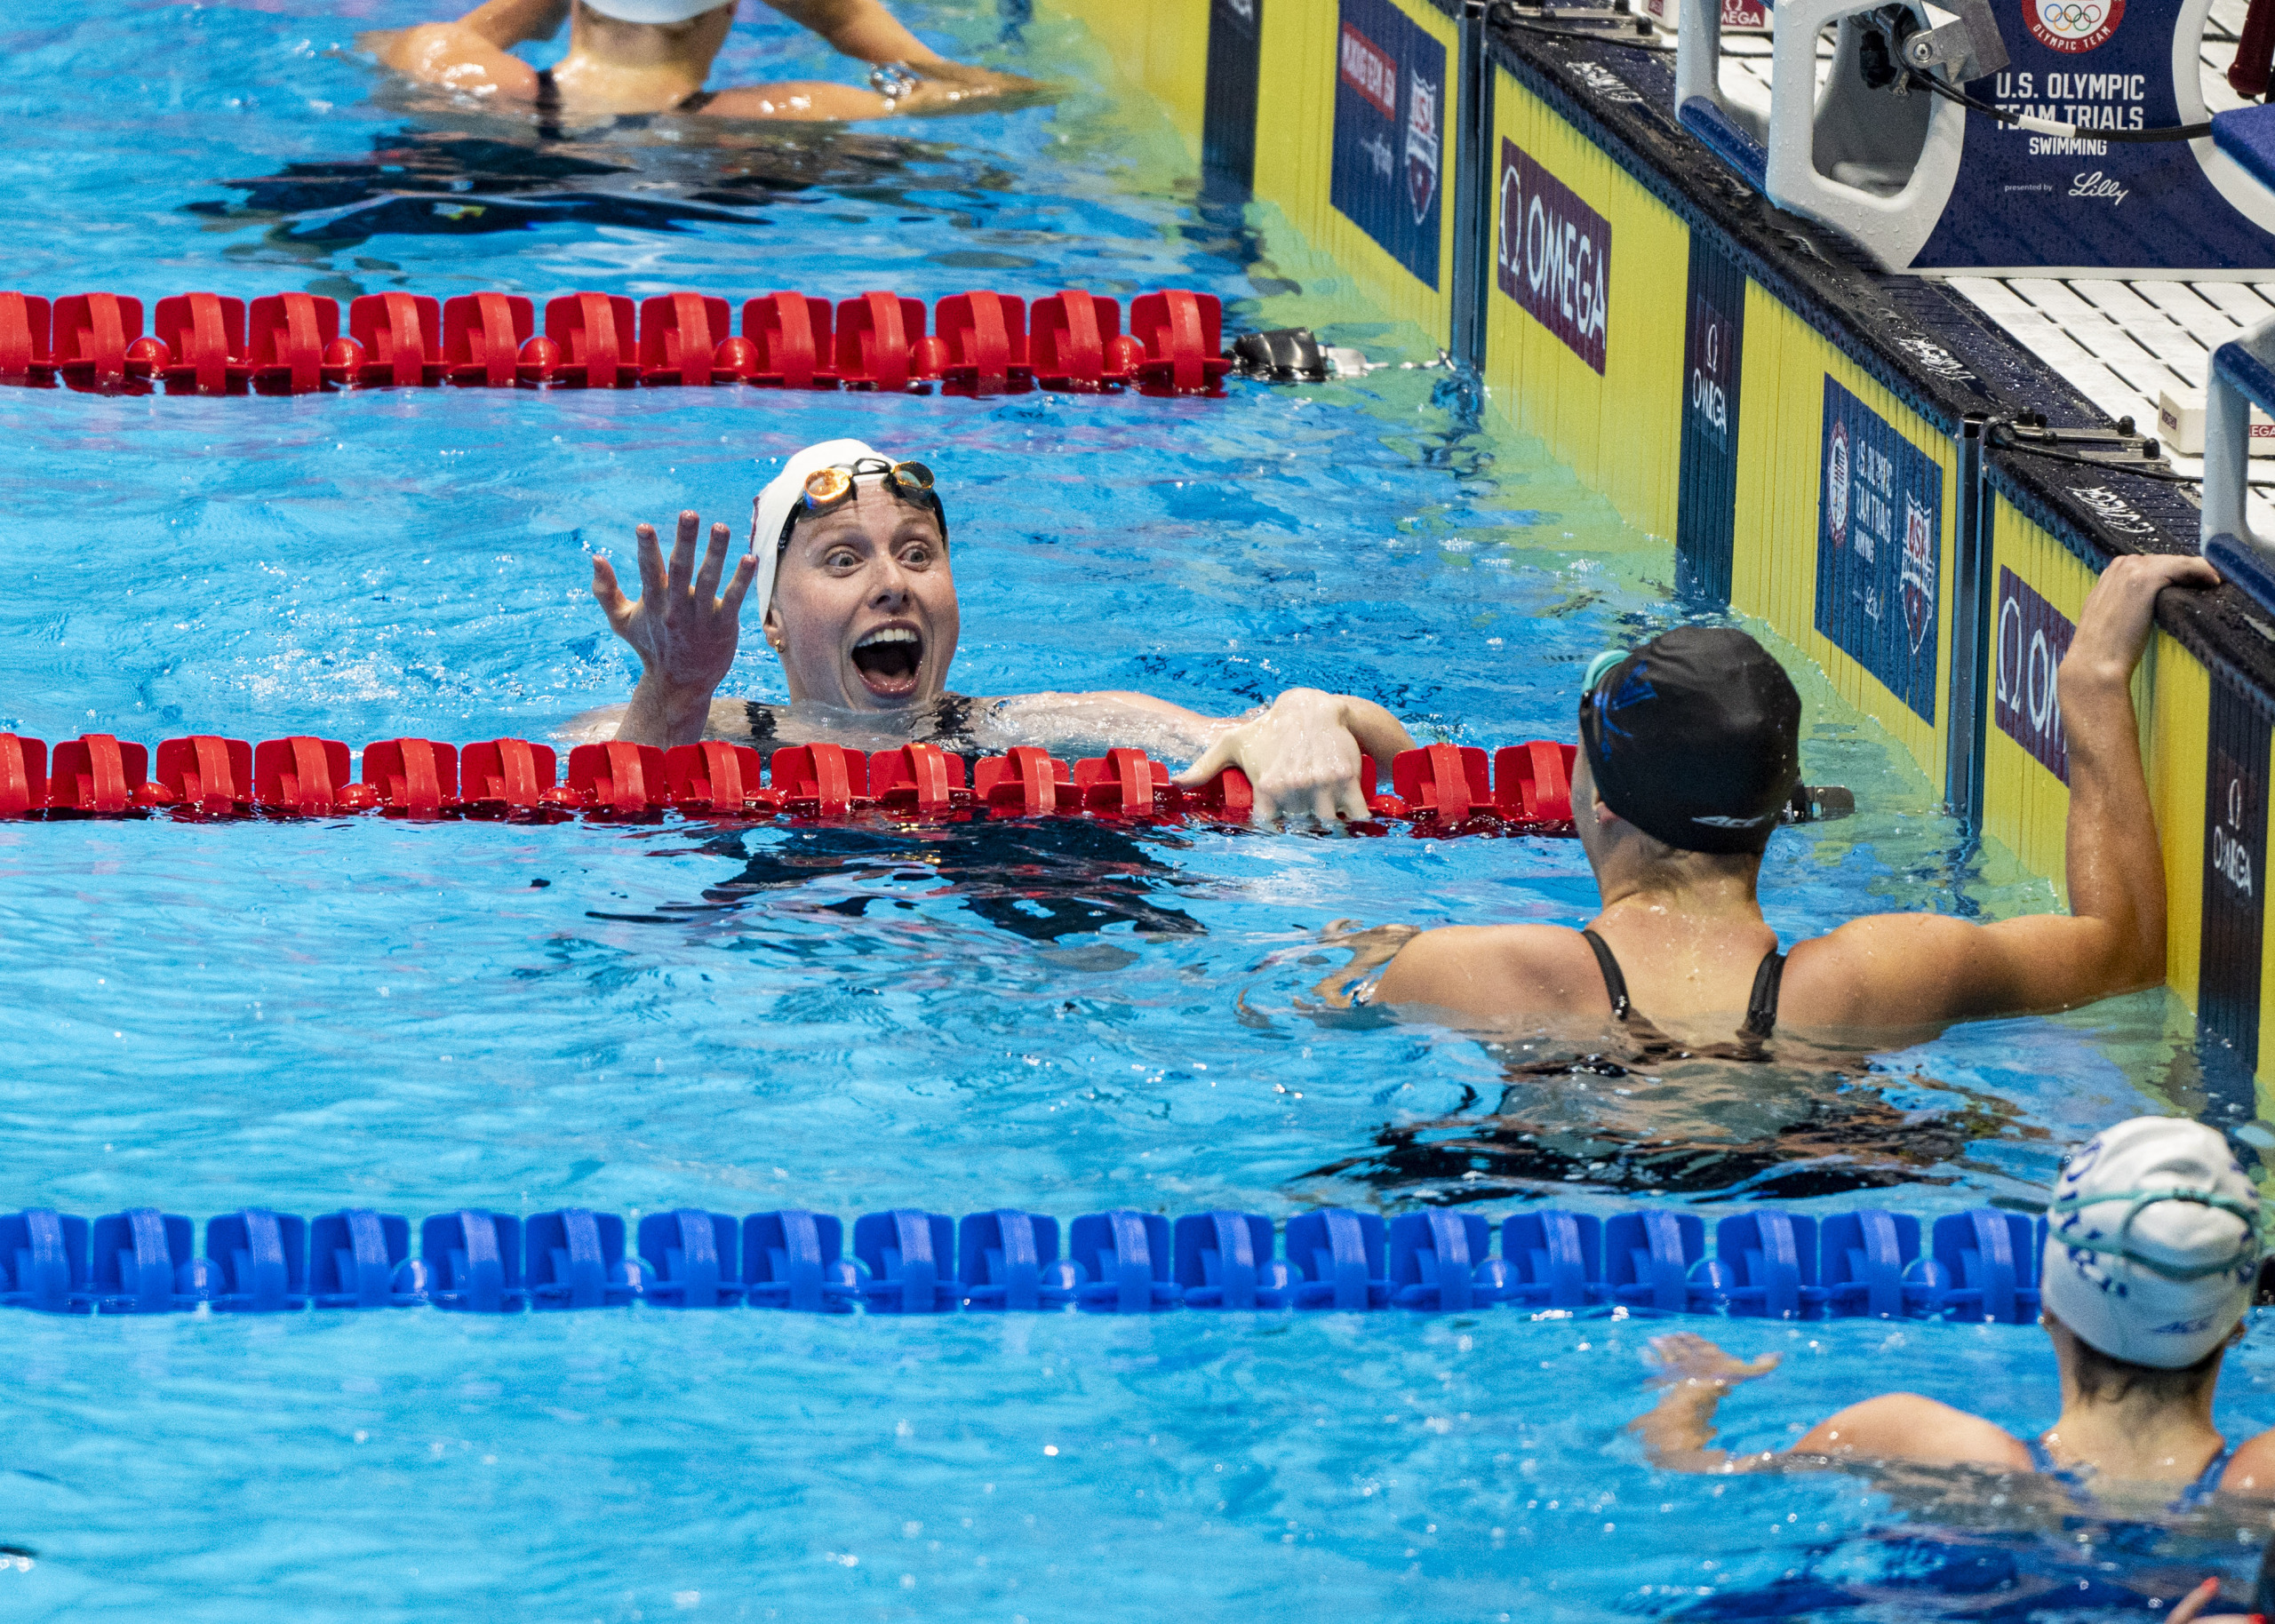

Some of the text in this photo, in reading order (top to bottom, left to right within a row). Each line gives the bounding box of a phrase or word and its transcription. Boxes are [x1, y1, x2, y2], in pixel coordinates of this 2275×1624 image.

[1720, 11, 1760, 25] MEGA
[2032, 23, 2111, 51] OLYMPIC TEAM
[1996, 73, 2145, 100] U.S. OLYMPIC
[2063, 105, 2143, 131] TRIALS
[2029, 137, 2108, 156] SWIMMING
[2004, 184, 2042, 193] presented
[2068, 171, 2129, 206] Lilly
[1527, 194, 1606, 350] OMEGA
[1693, 368, 1728, 435] OMEGA
[2250, 426, 2275, 437] EGA
